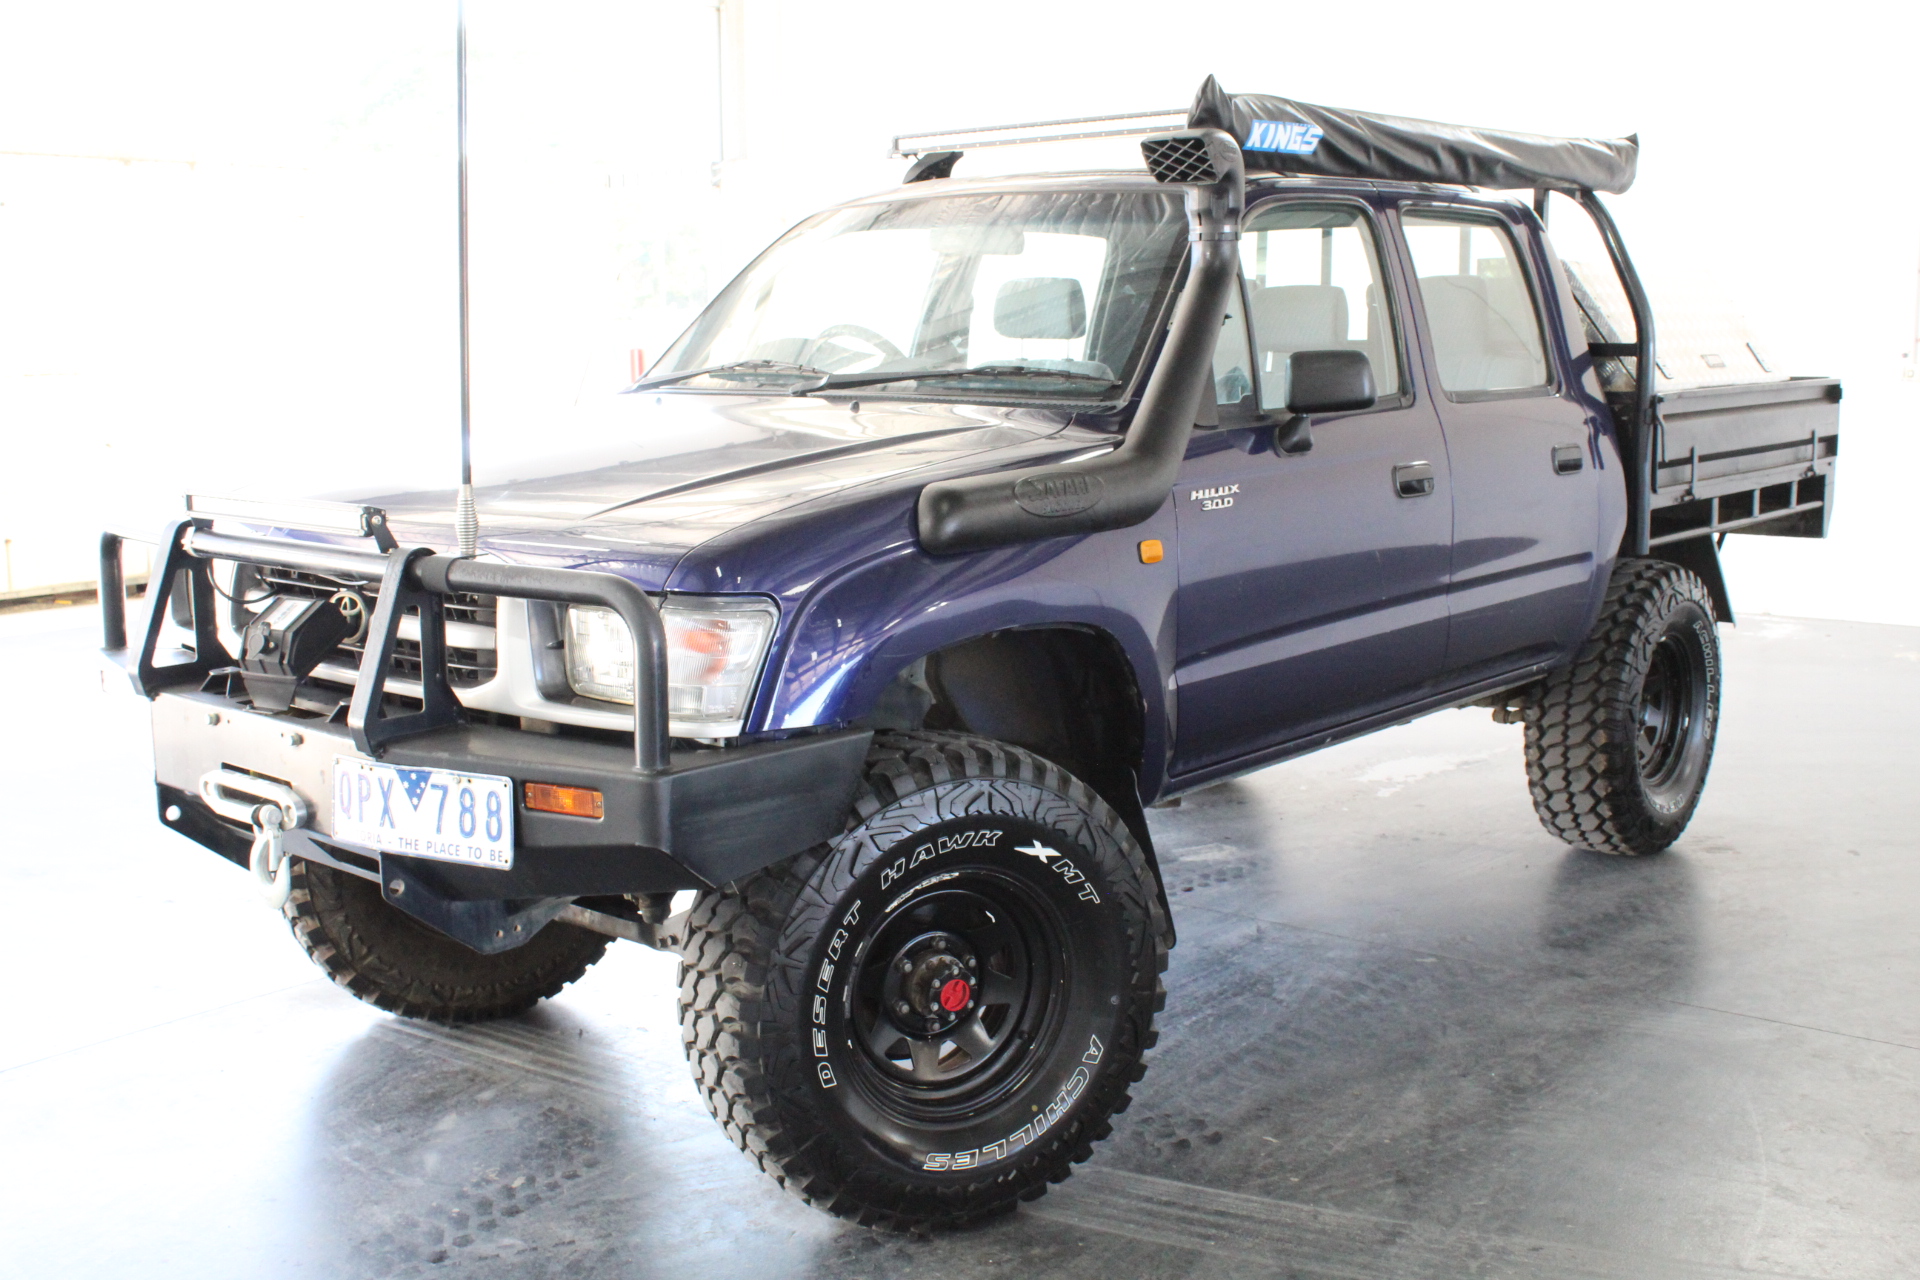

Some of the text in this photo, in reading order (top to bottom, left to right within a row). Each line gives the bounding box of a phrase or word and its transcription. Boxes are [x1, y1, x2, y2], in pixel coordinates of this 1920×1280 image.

[1244, 121, 1324, 153] KINGS
[1190, 483, 1240, 501] HILUX
[338, 770, 503, 842] QPX 788
[399, 837, 420, 851] THE
[426, 841, 461, 857] PLACE
[467, 846, 483, 860] TO
[490, 849, 504, 863] BE
[812, 900, 861, 1088] DESERT
[880, 830, 1003, 890] HAWK
[922, 1034, 1105, 1171] ACHILLES
